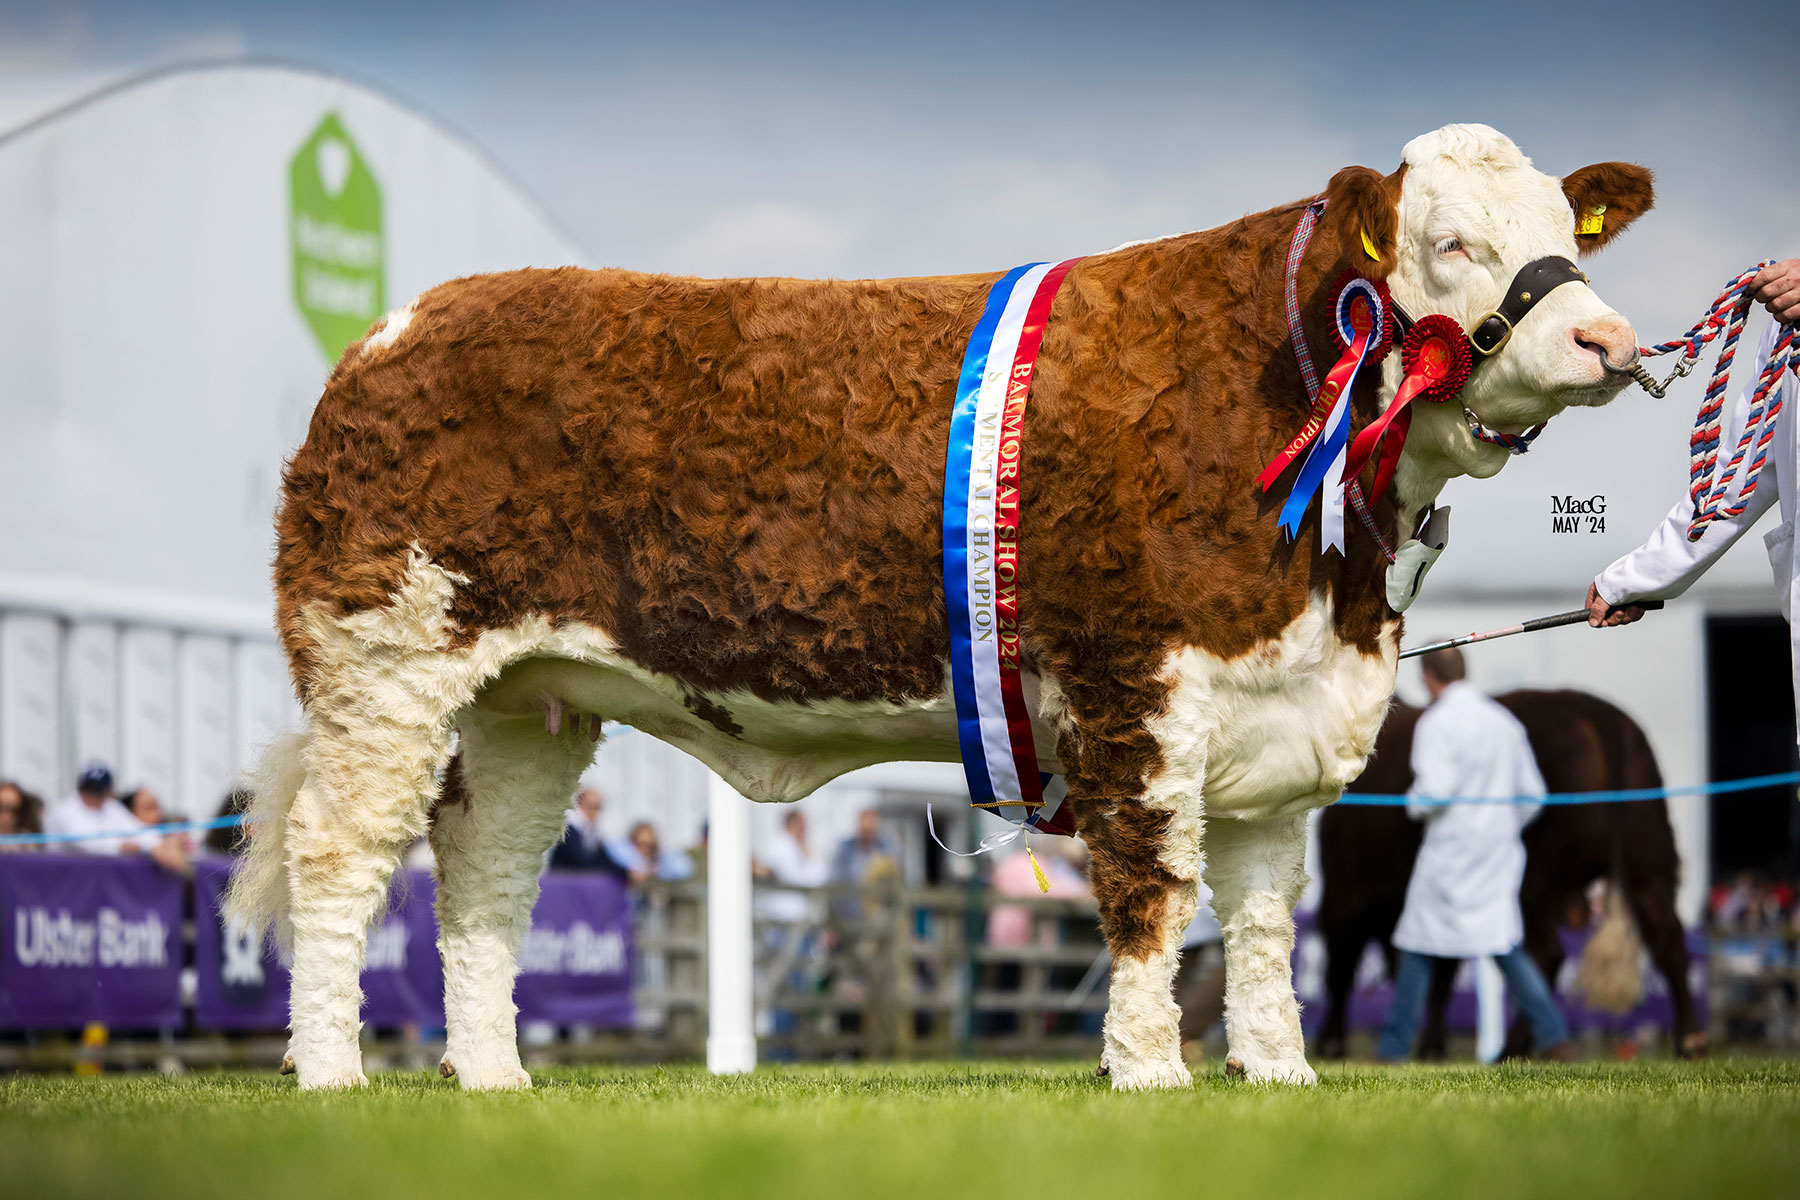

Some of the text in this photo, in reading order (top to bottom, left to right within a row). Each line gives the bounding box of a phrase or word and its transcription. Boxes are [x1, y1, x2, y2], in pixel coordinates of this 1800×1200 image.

[973, 371, 1003, 644] SMENTAL CHAMPION
[1284, 380, 1340, 459] CHAMPION
[997, 361, 1033, 670] BALMORAL SHOW 2024
[15, 905, 169, 968] Ulster Bank
